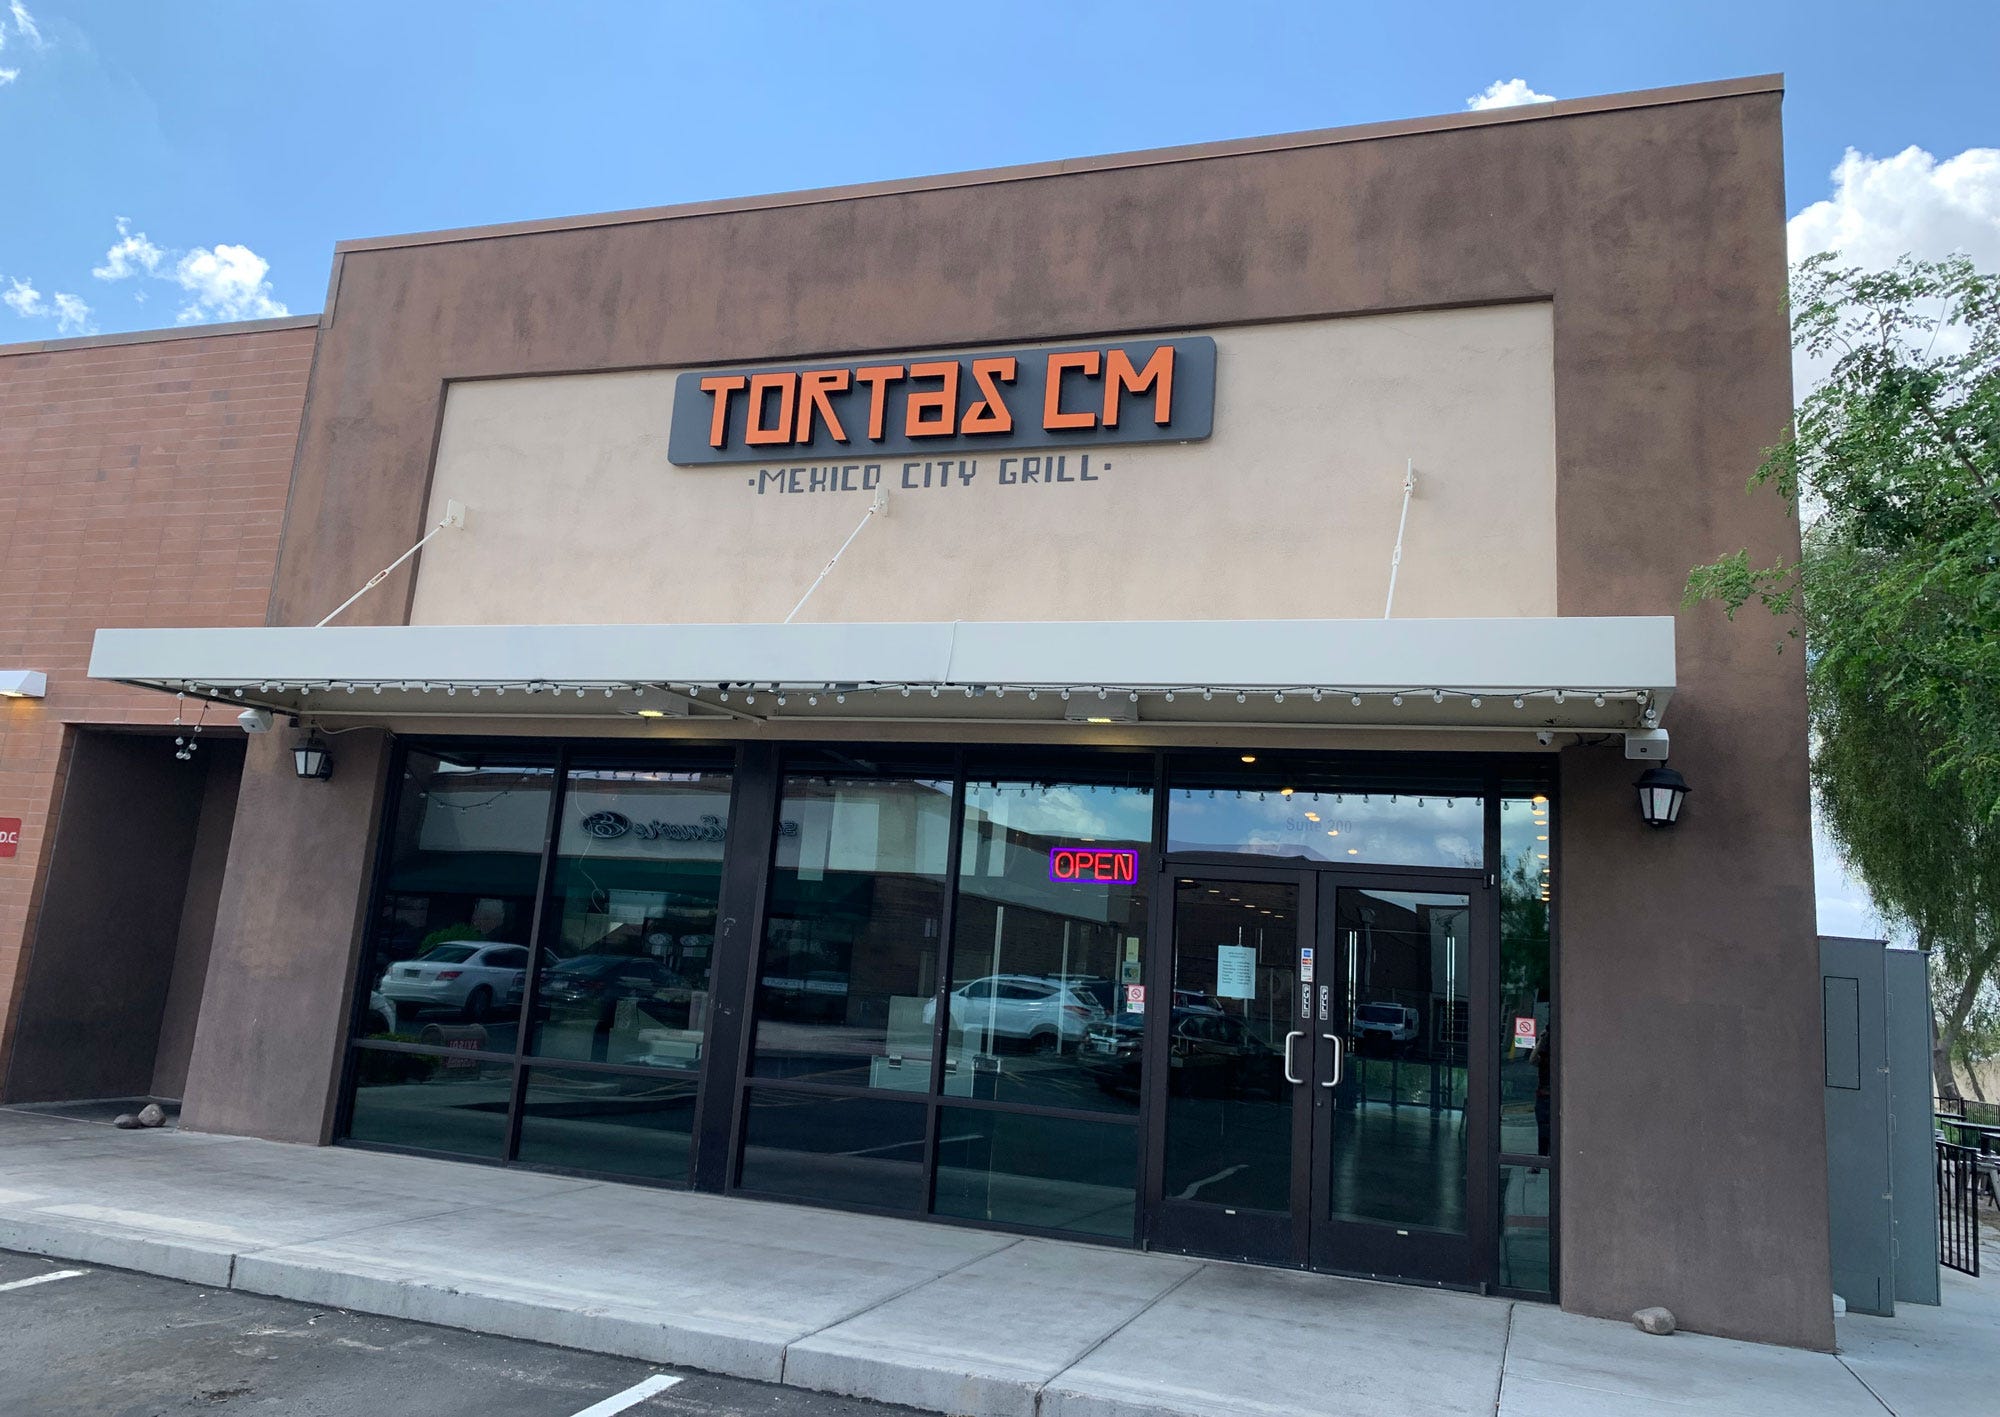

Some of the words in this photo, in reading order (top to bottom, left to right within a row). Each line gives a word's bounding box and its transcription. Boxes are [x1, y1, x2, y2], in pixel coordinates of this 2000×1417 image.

[1042, 345, 1176, 431] CM
[757, 463, 882, 495] MEXICO
[901, 459, 977, 488] CITY
[998, 454, 1099, 485] GRILL
[1327, 818, 1352, 834] 200
[1054, 851, 1133, 881] OPEN
